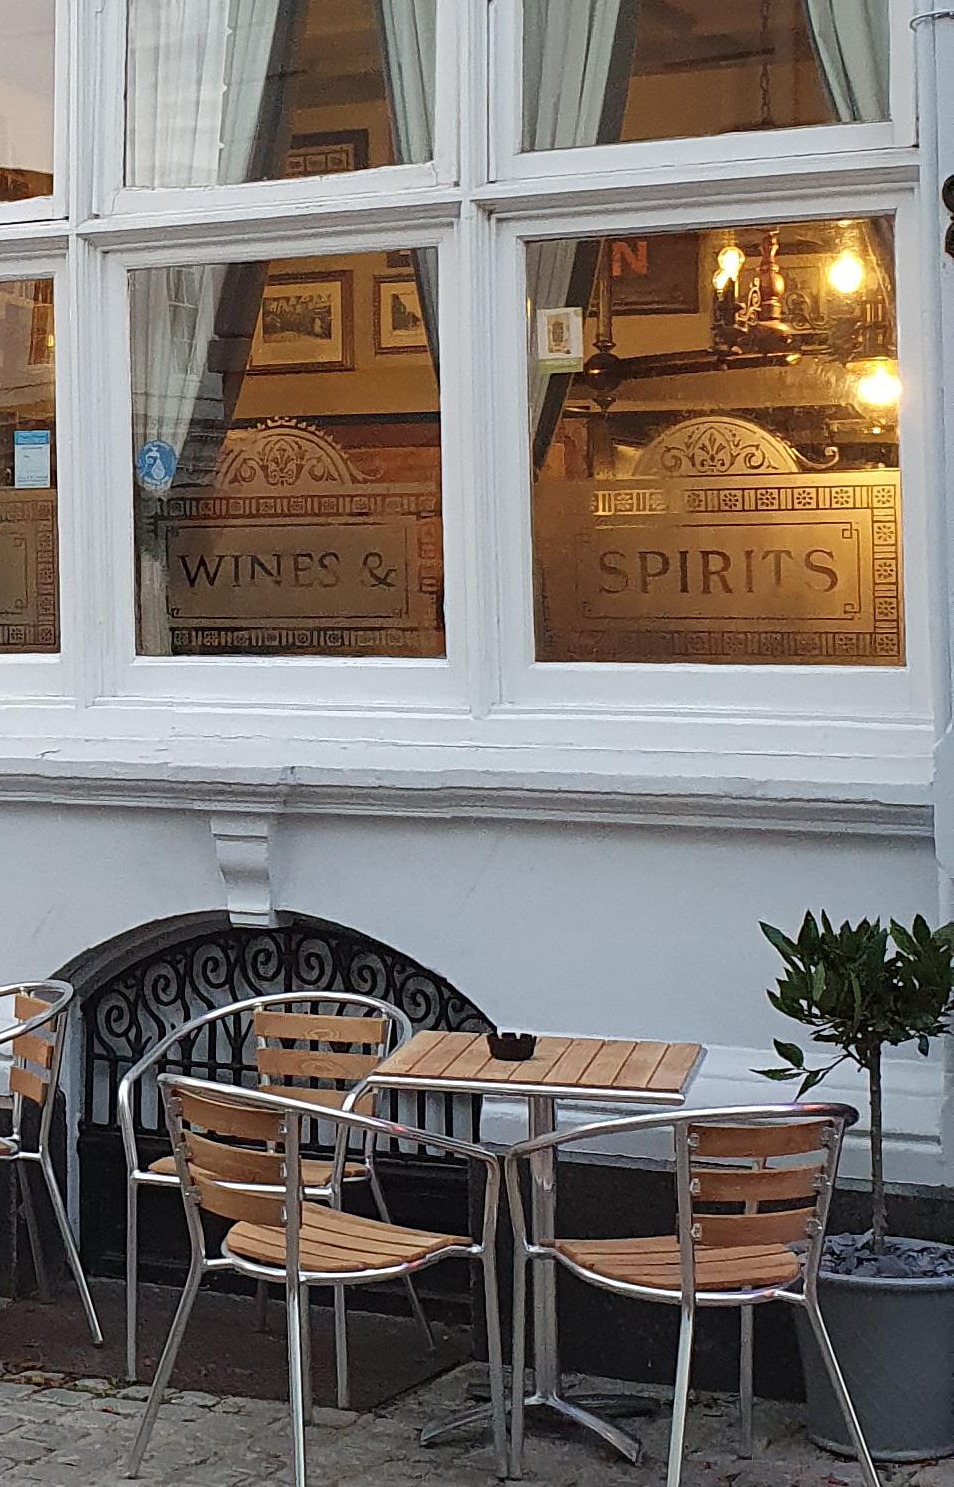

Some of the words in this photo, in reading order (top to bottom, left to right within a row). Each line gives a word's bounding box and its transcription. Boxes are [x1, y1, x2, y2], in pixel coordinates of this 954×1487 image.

[178, 552, 341, 588] WINES
[362, 551, 399, 588] &
[598, 549, 839, 595] SPIRITS
